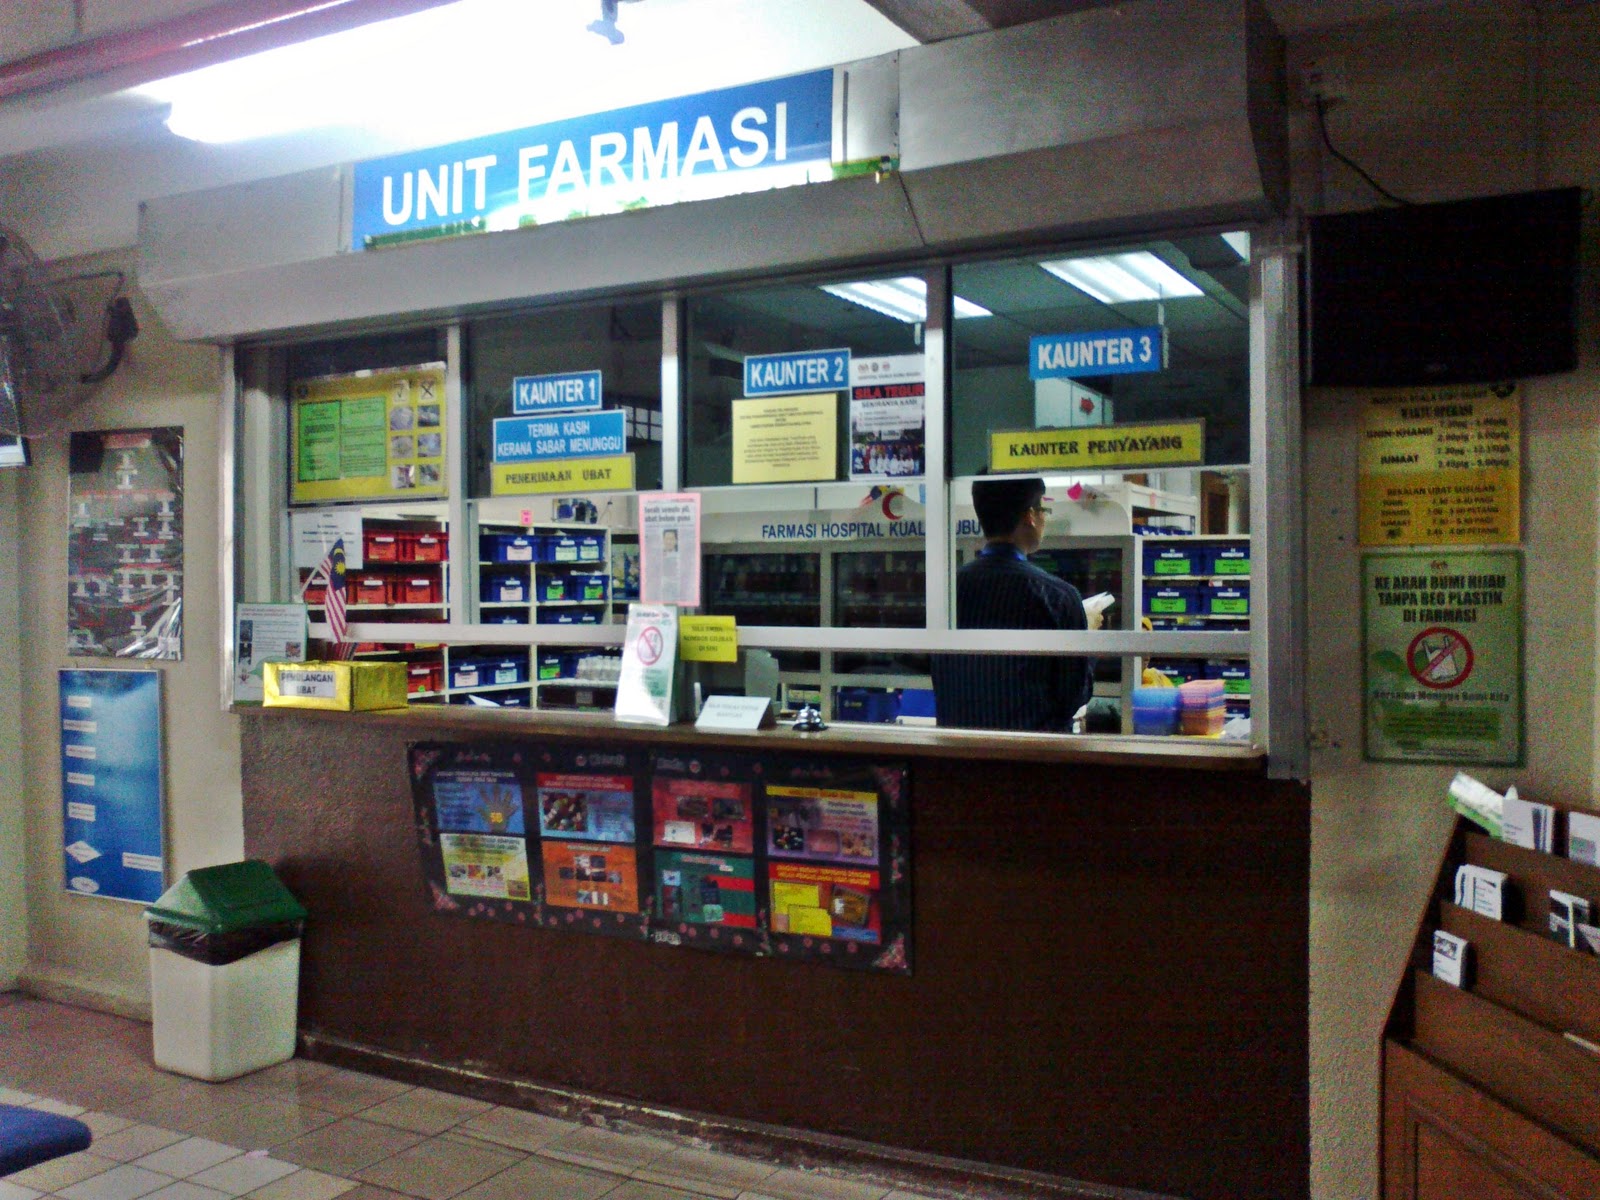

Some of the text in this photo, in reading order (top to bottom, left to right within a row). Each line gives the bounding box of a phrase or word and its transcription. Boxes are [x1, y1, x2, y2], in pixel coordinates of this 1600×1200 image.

[382, 101, 788, 225] UNIT FARMASI
[1038, 336, 1151, 370] KAUNTER 3
[751, 357, 844, 388] KAUNTER 2
[519, 378, 595, 406] KAUNTER 1
[855, 384, 924, 399] SILA TEGUR
[527, 420, 590, 438] TERIMA KASIH
[497, 436, 621, 456] KERANA SABAR MENUNGGU
[1009, 435, 1183, 457] KAUNTER PENYAYANG
[505, 468, 612, 484] PENERIMAAN UBAT
[762, 519, 981, 539] FARMASI HOSPITAL KUAL UBU
[1374, 575, 1507, 590] KE ARAH BUMI HIJAU
[1378, 591, 1503, 606] TANPA BEG PLASTIK
[1403, 608, 1477, 622] DI FARMASI
